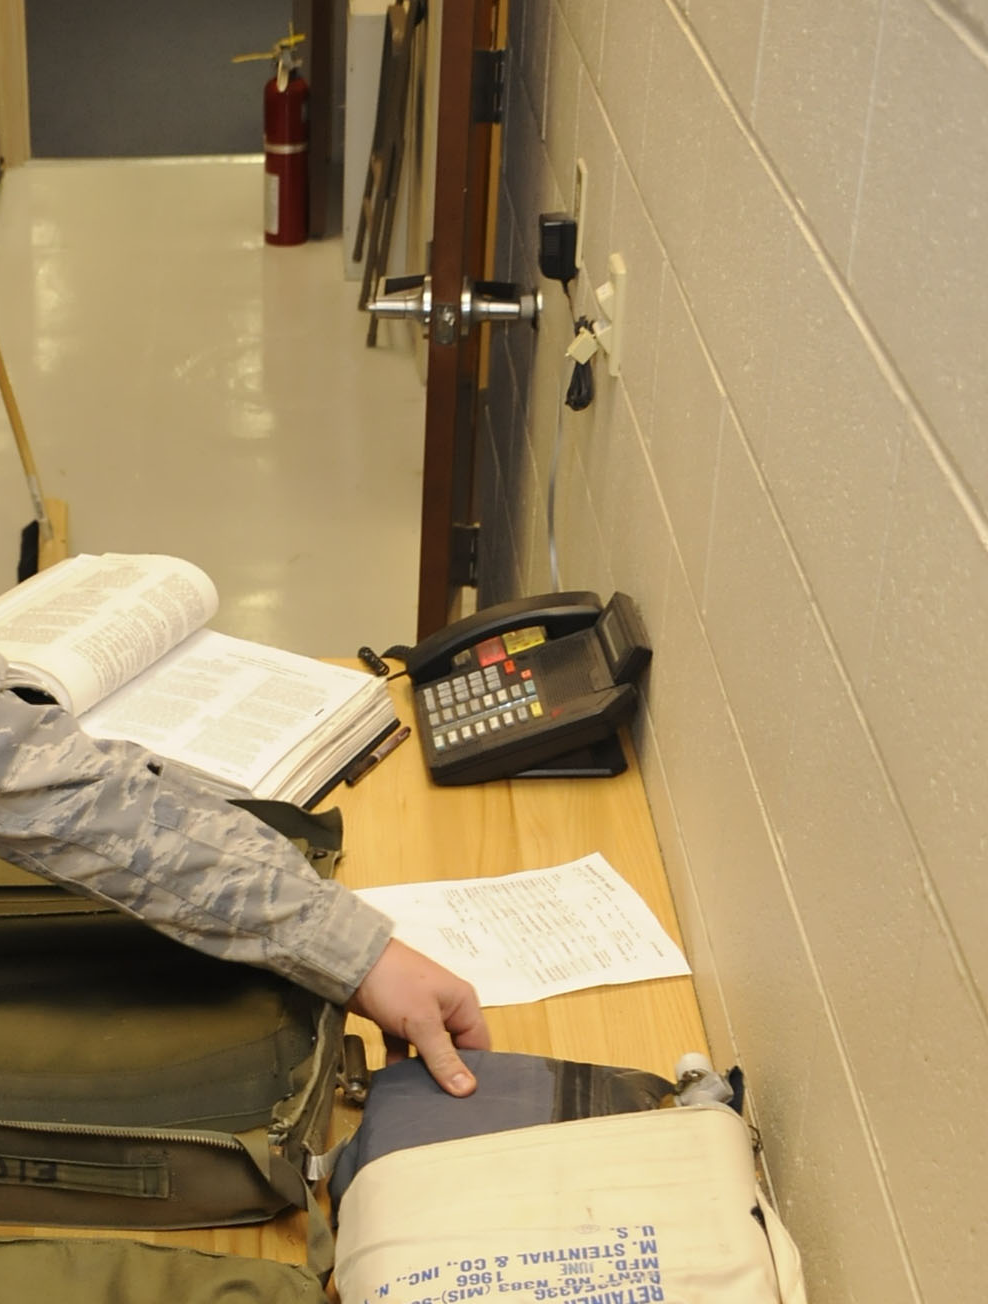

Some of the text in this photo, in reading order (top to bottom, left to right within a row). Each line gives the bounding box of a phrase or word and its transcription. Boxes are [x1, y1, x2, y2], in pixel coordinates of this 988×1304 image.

[608, 1224, 656, 1239] U. S.
[516, 1244, 626, 1266] STEINTHAL
[632, 1239, 658, 1255] M.
[493, 1255, 509, 1269] &
[607, 1256, 660, 1272] MFD.
[456, 1270, 505, 1288] 1966
[497, 1279, 549, 1293] N383
